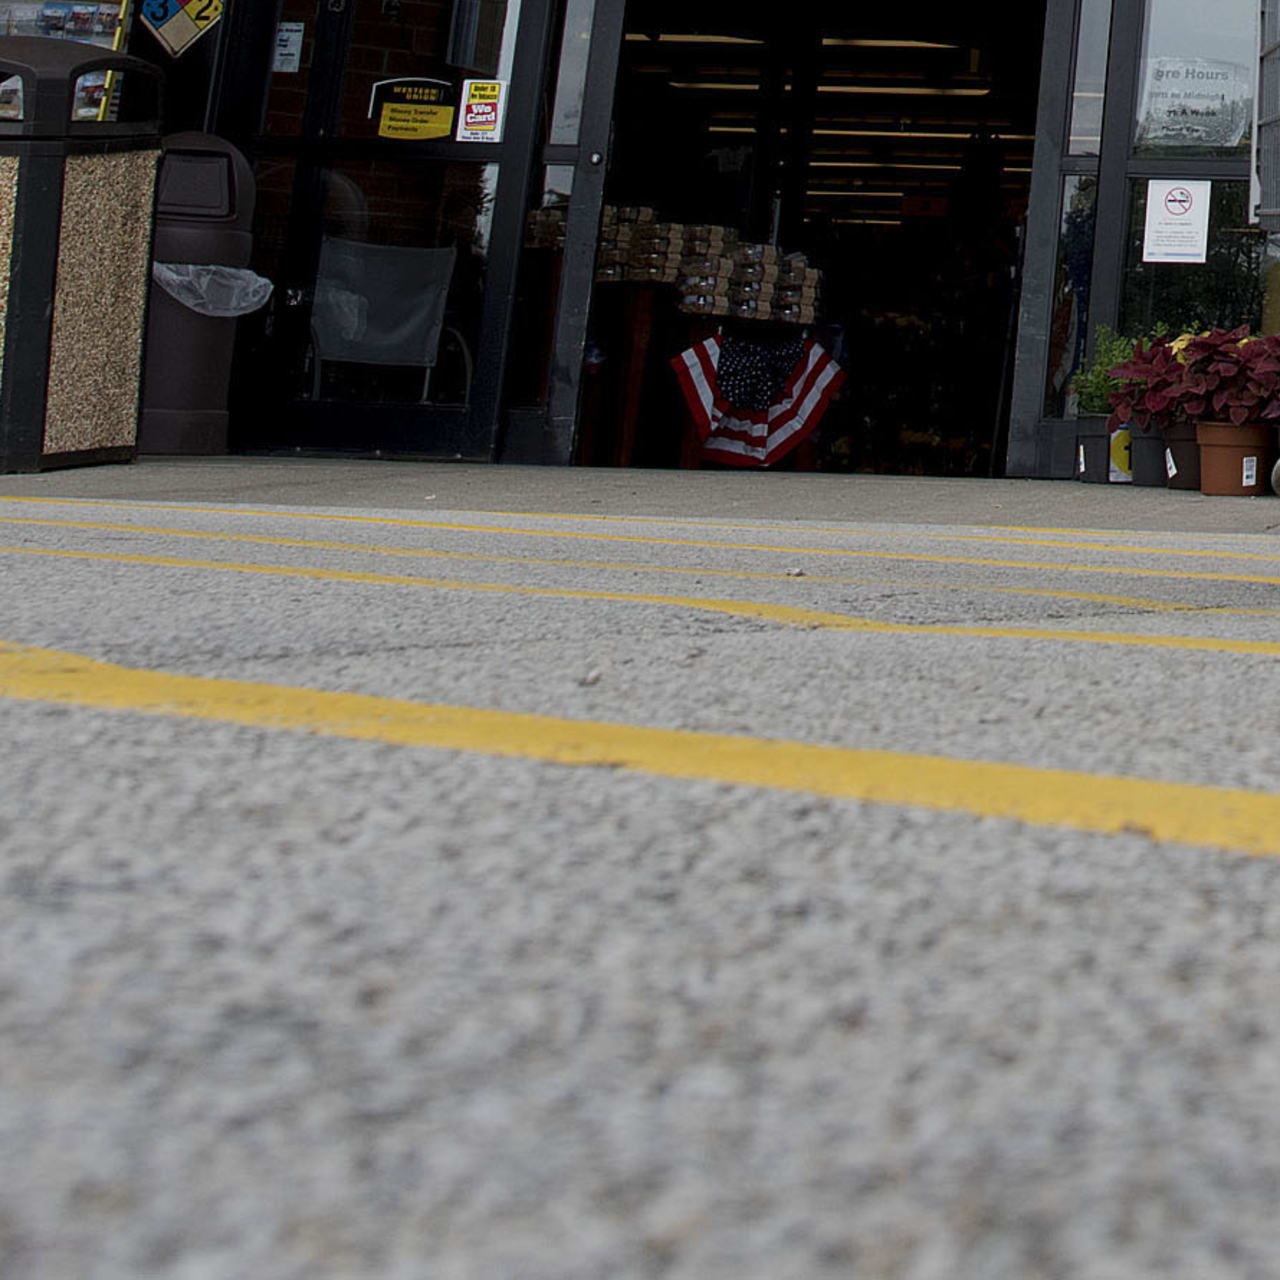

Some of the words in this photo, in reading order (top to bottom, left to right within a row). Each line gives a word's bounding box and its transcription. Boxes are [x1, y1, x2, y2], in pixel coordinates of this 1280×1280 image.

[1184, 67, 1229, 80] Hours
[471, 104, 492, 113] We
[467, 111, 495, 123] Card
